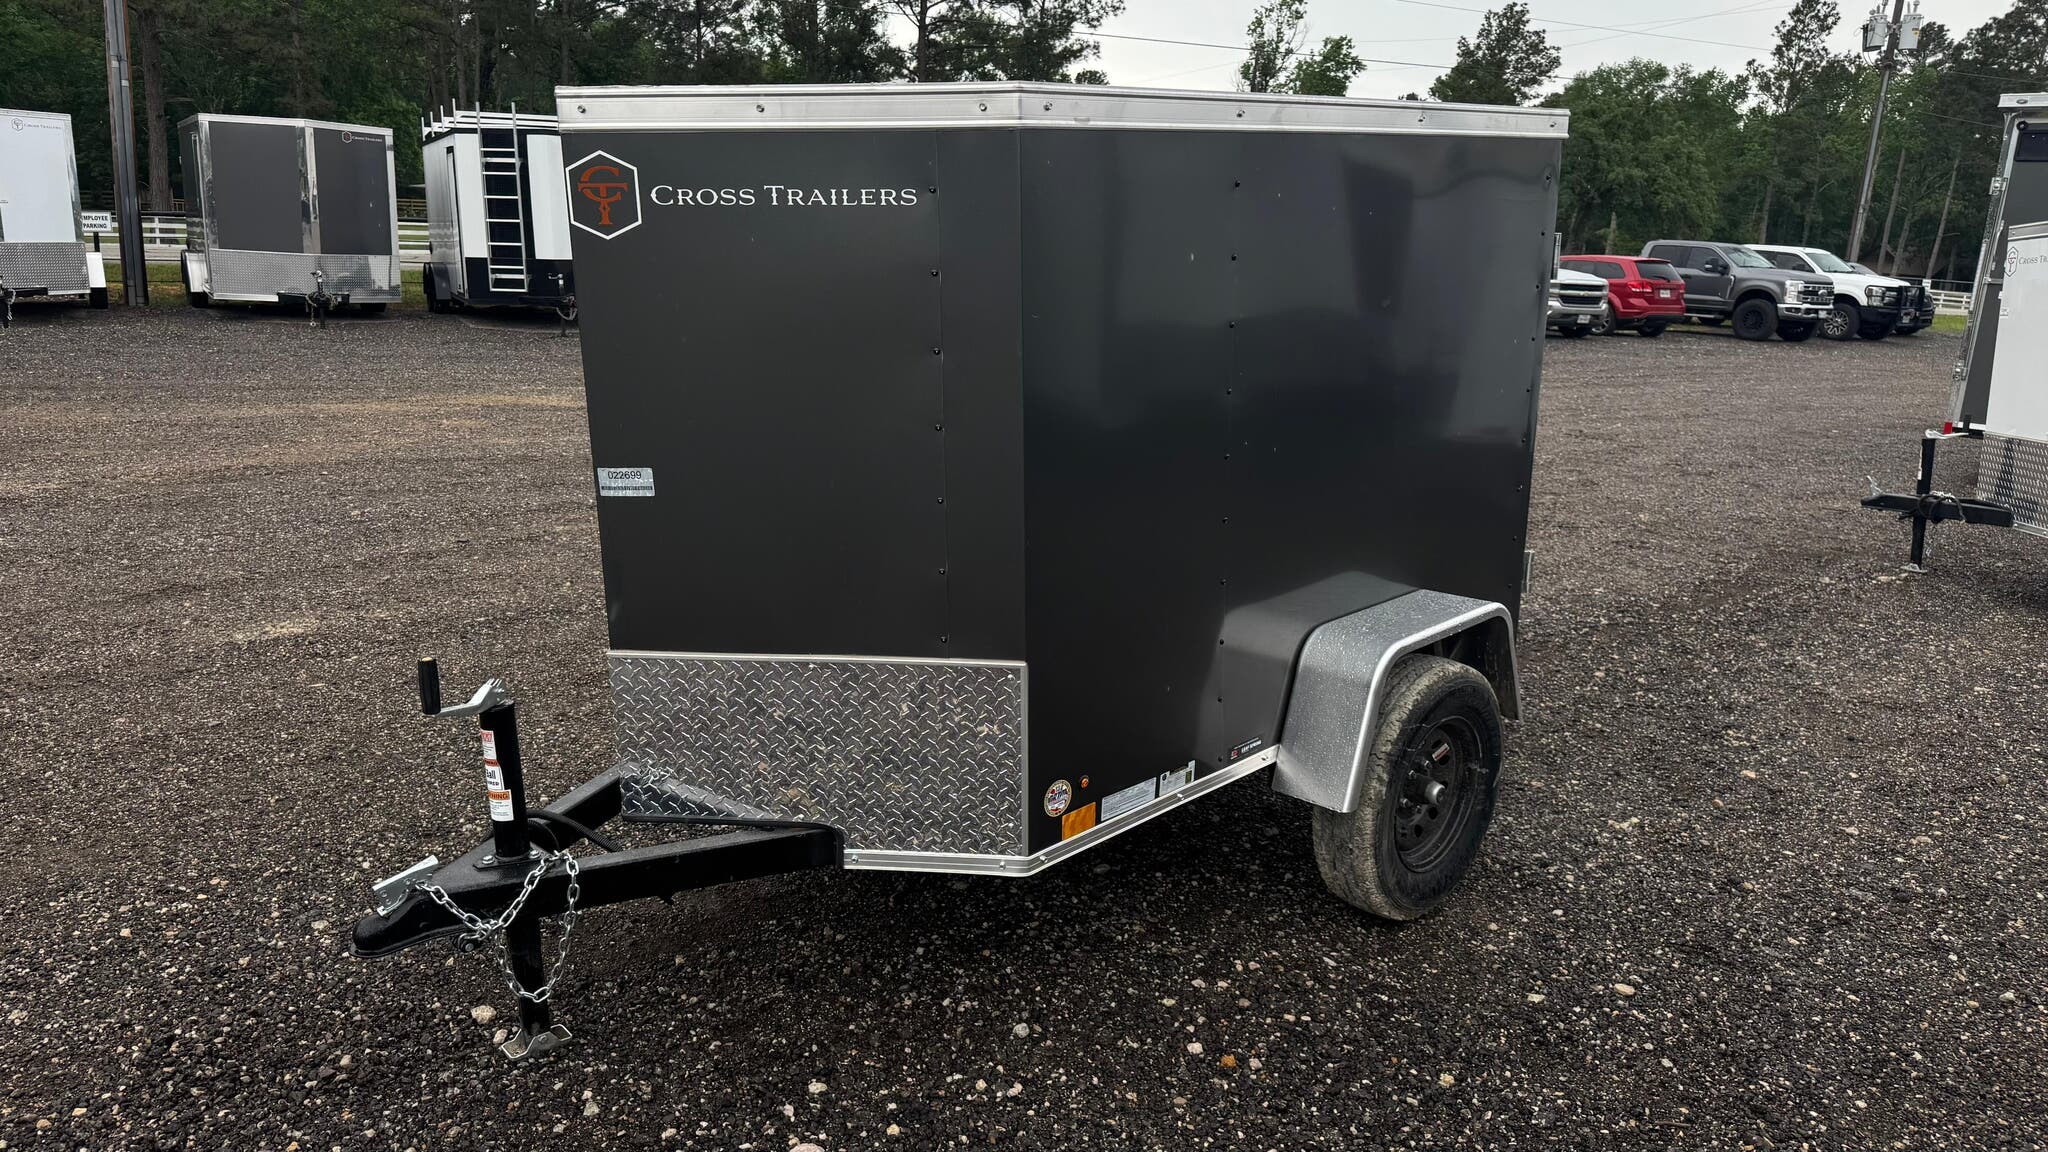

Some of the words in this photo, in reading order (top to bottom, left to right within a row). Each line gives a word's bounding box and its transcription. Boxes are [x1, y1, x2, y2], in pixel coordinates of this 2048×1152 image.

[650, 184, 756, 206] CROSS
[763, 184, 918, 206] TRAILERS
[607, 470, 642, 480] 022699
